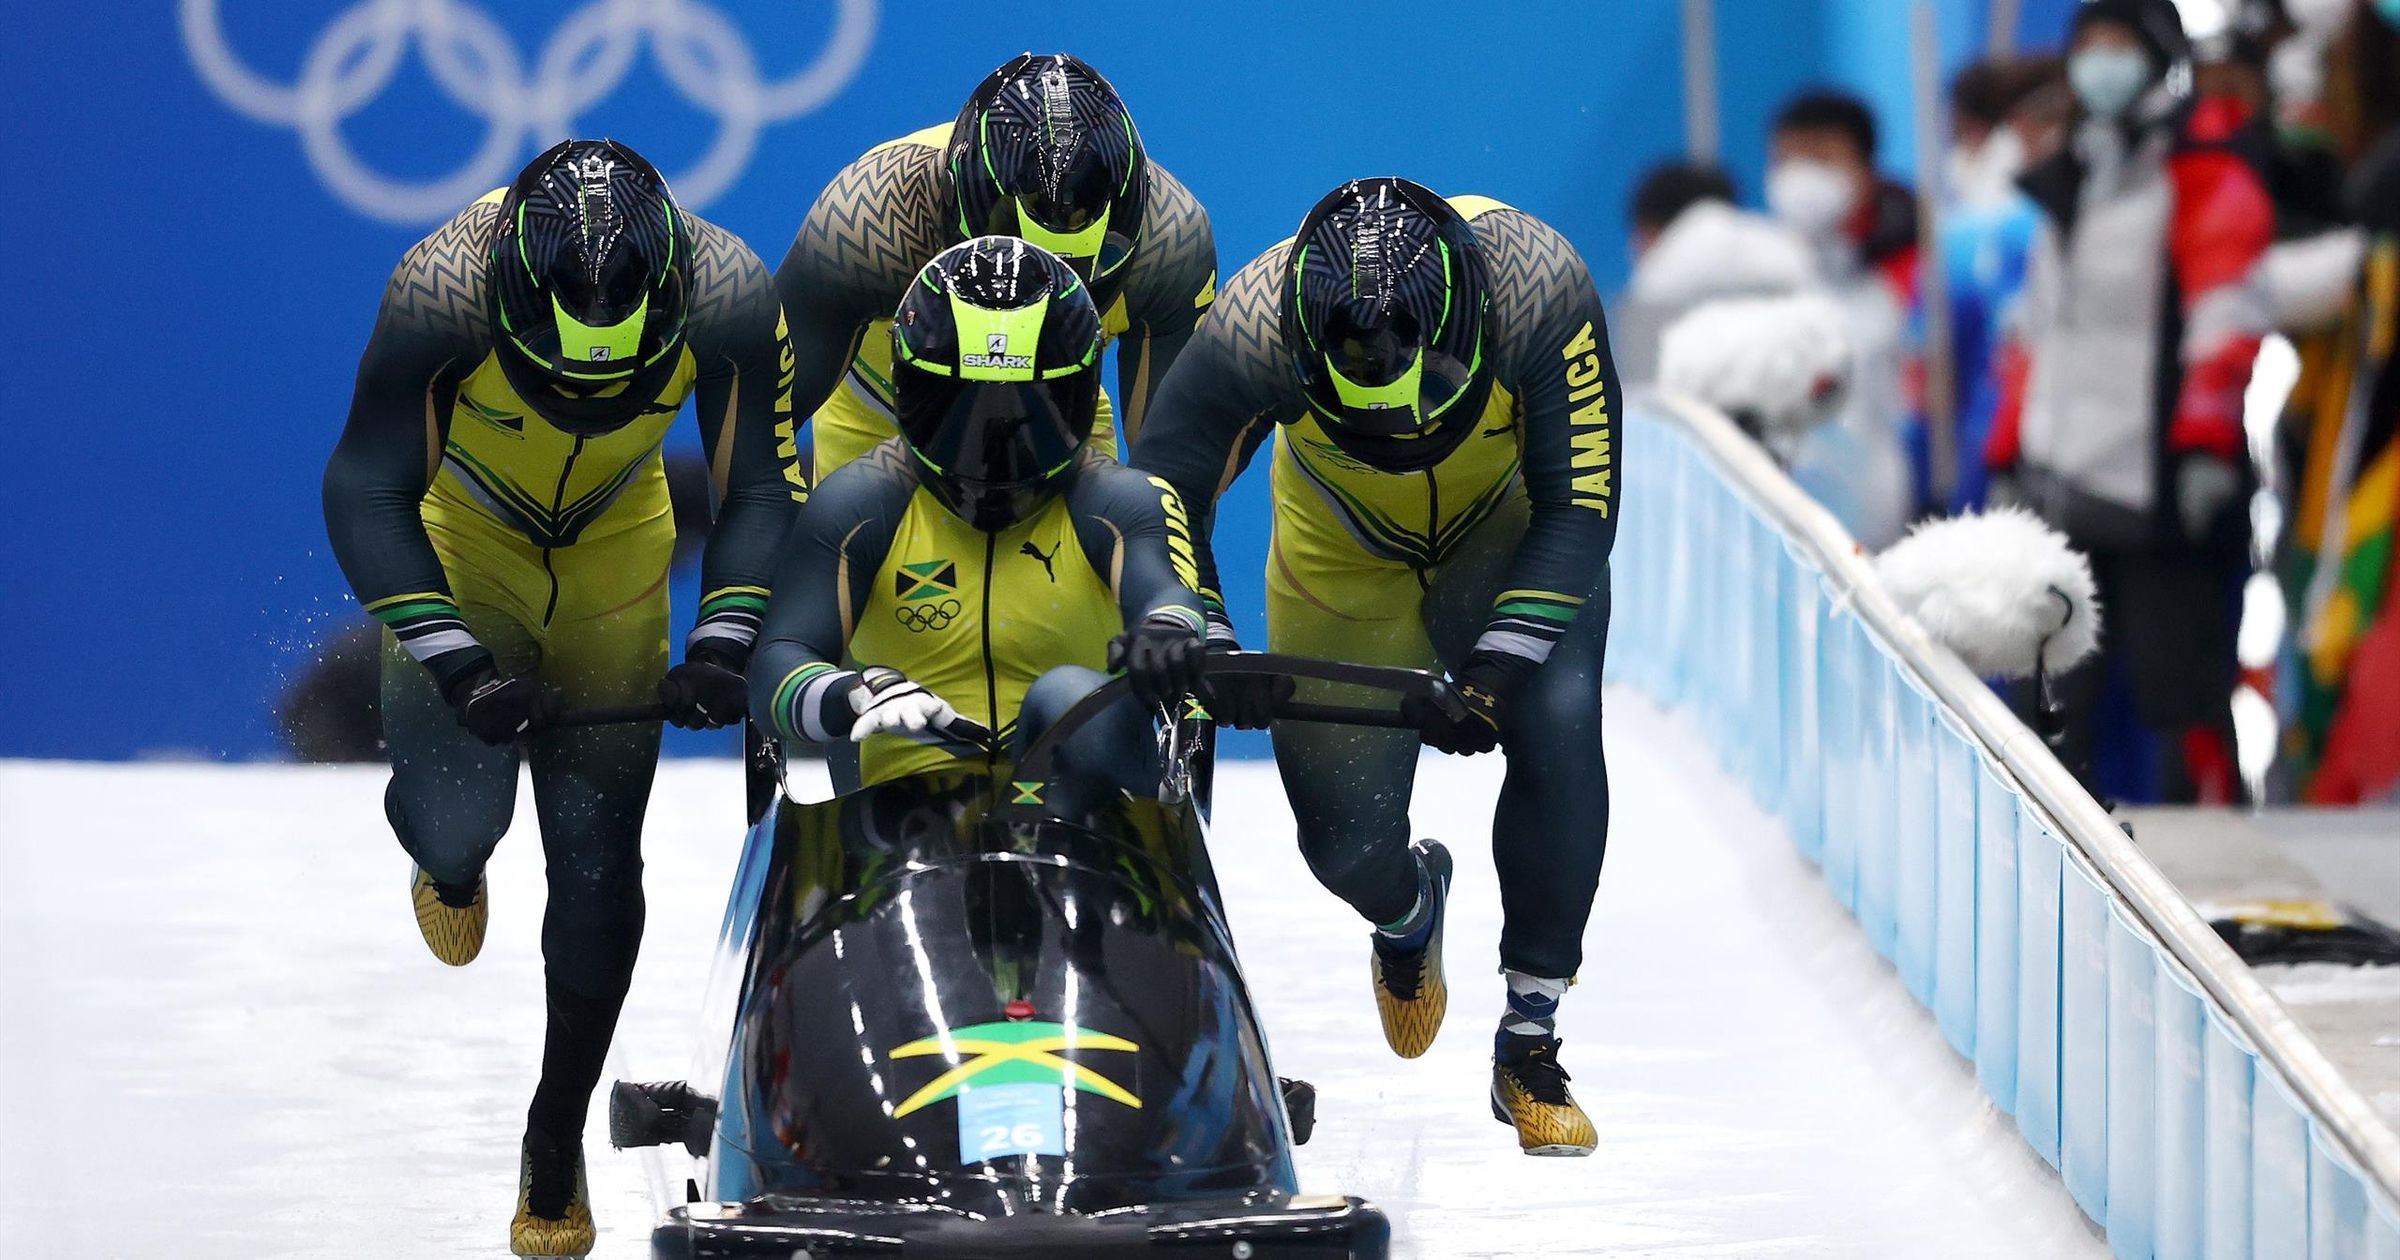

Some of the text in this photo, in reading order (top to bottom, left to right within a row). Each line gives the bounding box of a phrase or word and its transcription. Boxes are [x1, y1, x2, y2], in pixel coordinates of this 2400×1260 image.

[962, 354, 1031, 369] SHARK
[1562, 320, 1611, 519] JAMAICA
[1147, 476, 1200, 594] MAIC
[979, 1122, 1045, 1152] 26
